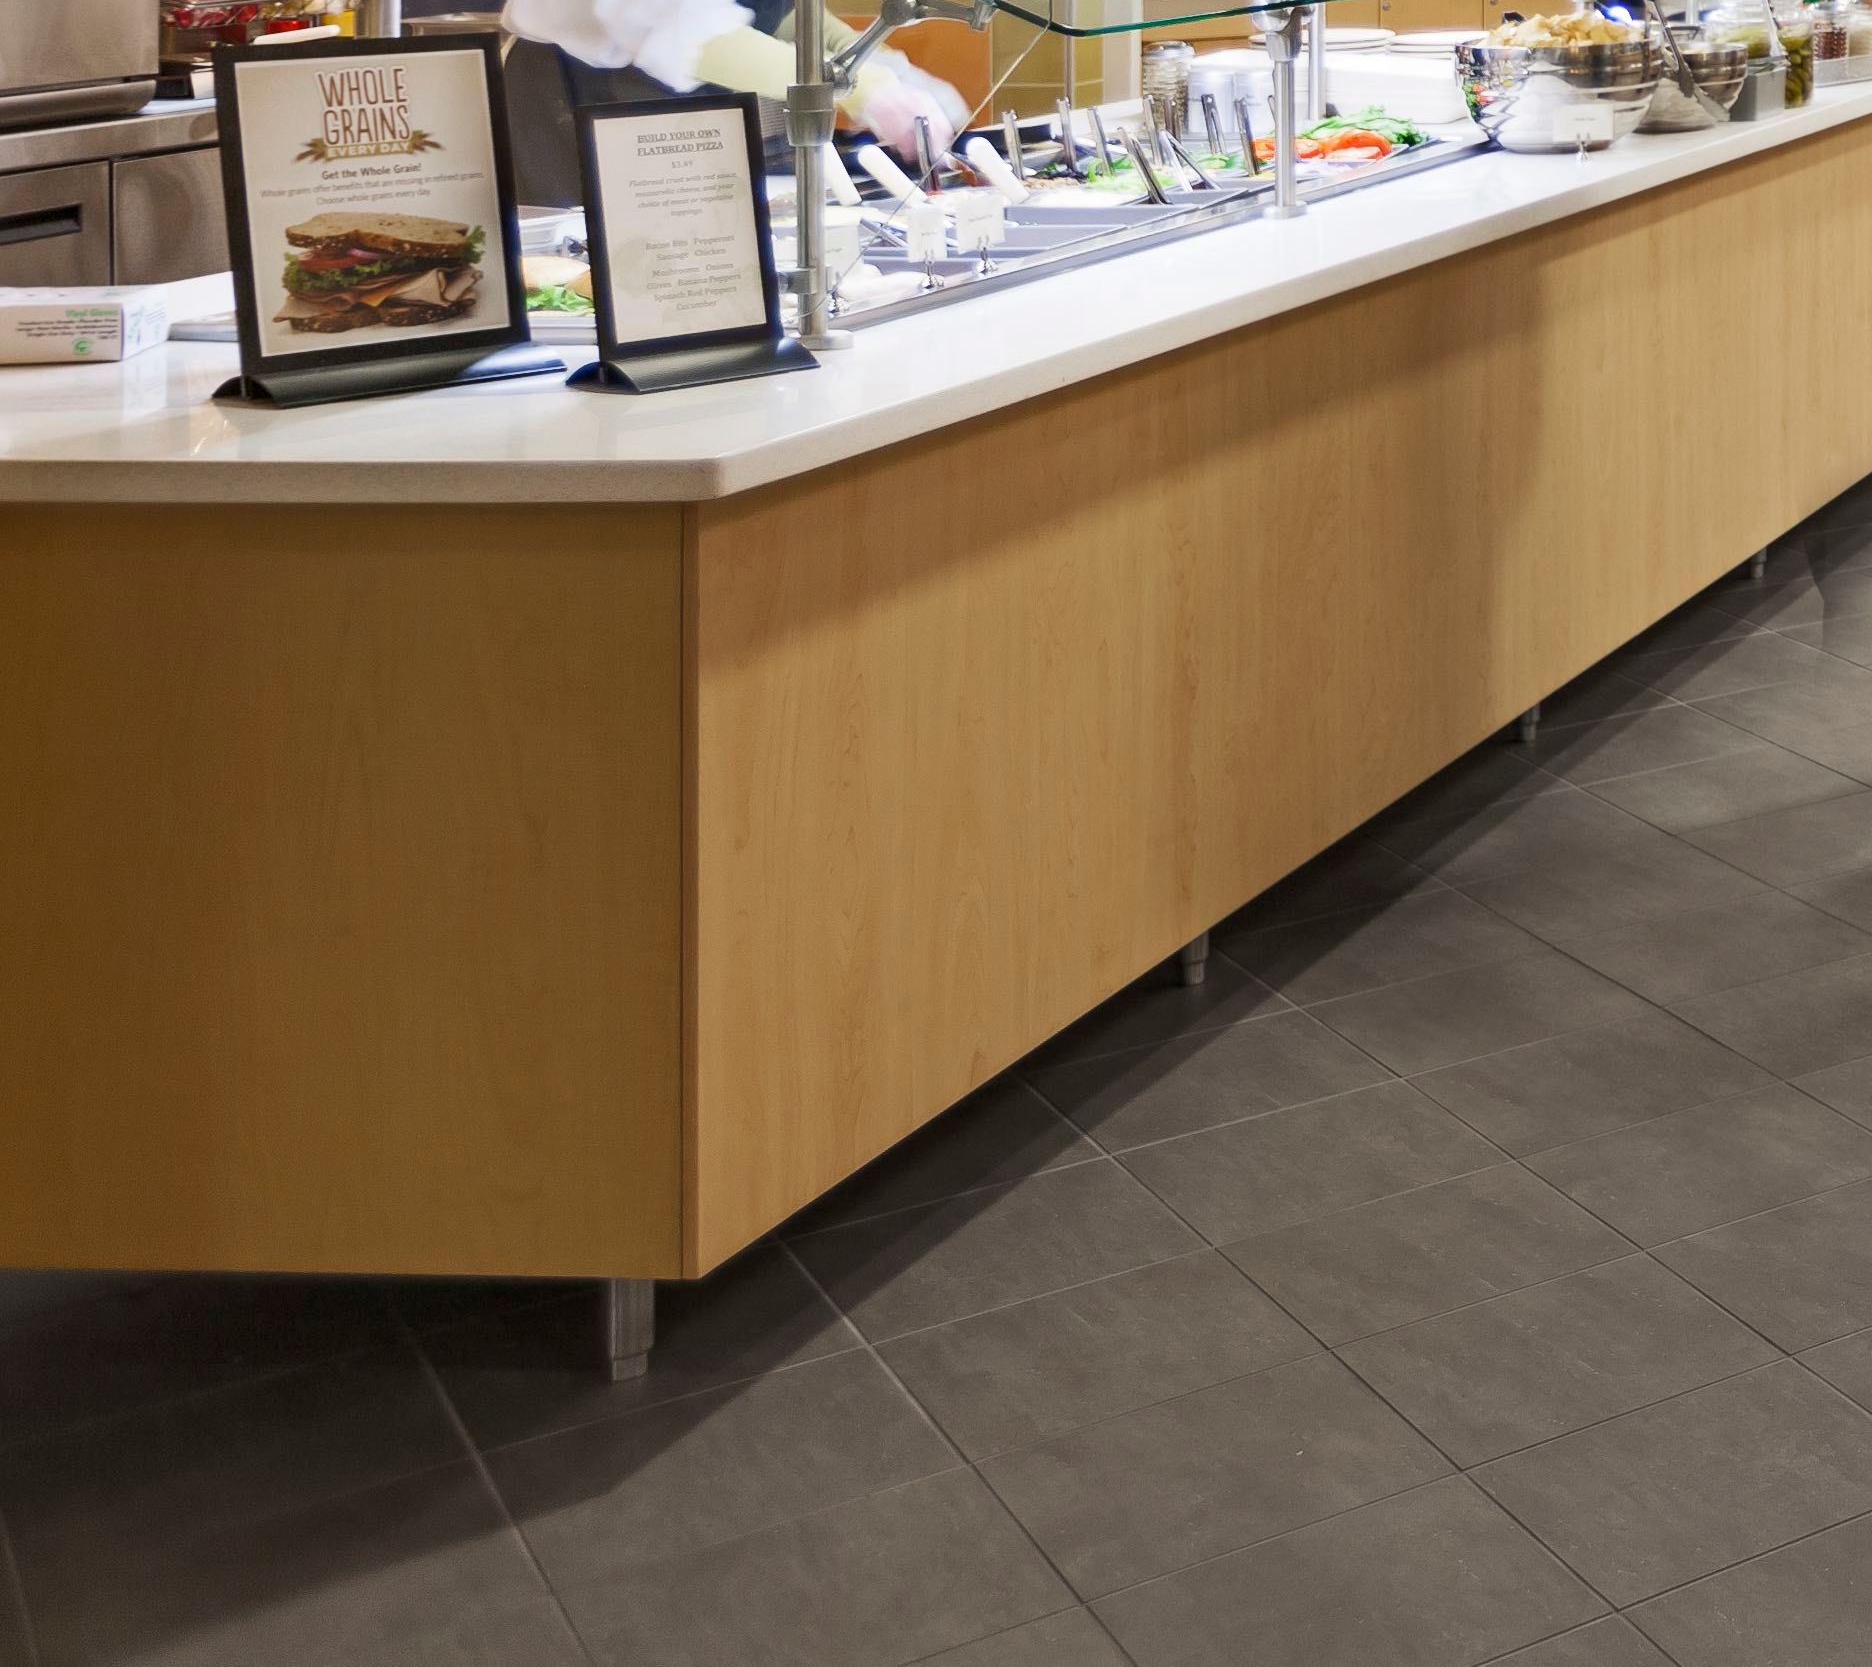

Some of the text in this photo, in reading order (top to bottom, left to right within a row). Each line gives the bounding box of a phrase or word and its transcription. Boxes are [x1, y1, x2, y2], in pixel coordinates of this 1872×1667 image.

[317, 68, 407, 107] WHOLE
[323, 104, 412, 146] GRAINS
[637, 129, 721, 144] BUILD YOUR OWN
[328, 143, 411, 158] EVERY DAY
[637, 141, 724, 157] FLATBREAD PIZZA
[322, 163, 422, 181] Get the Whole Grain!
[260, 189, 286, 198] Whole
[287, 186, 311, 198] grains
[313, 185, 331, 194] offer
[333, 182, 363, 192] benefits
[316, 196, 345, 206] Choose
[347, 194, 369, 203] whole
[371, 192, 394, 203] grains
[395, 190, 416, 201] every
